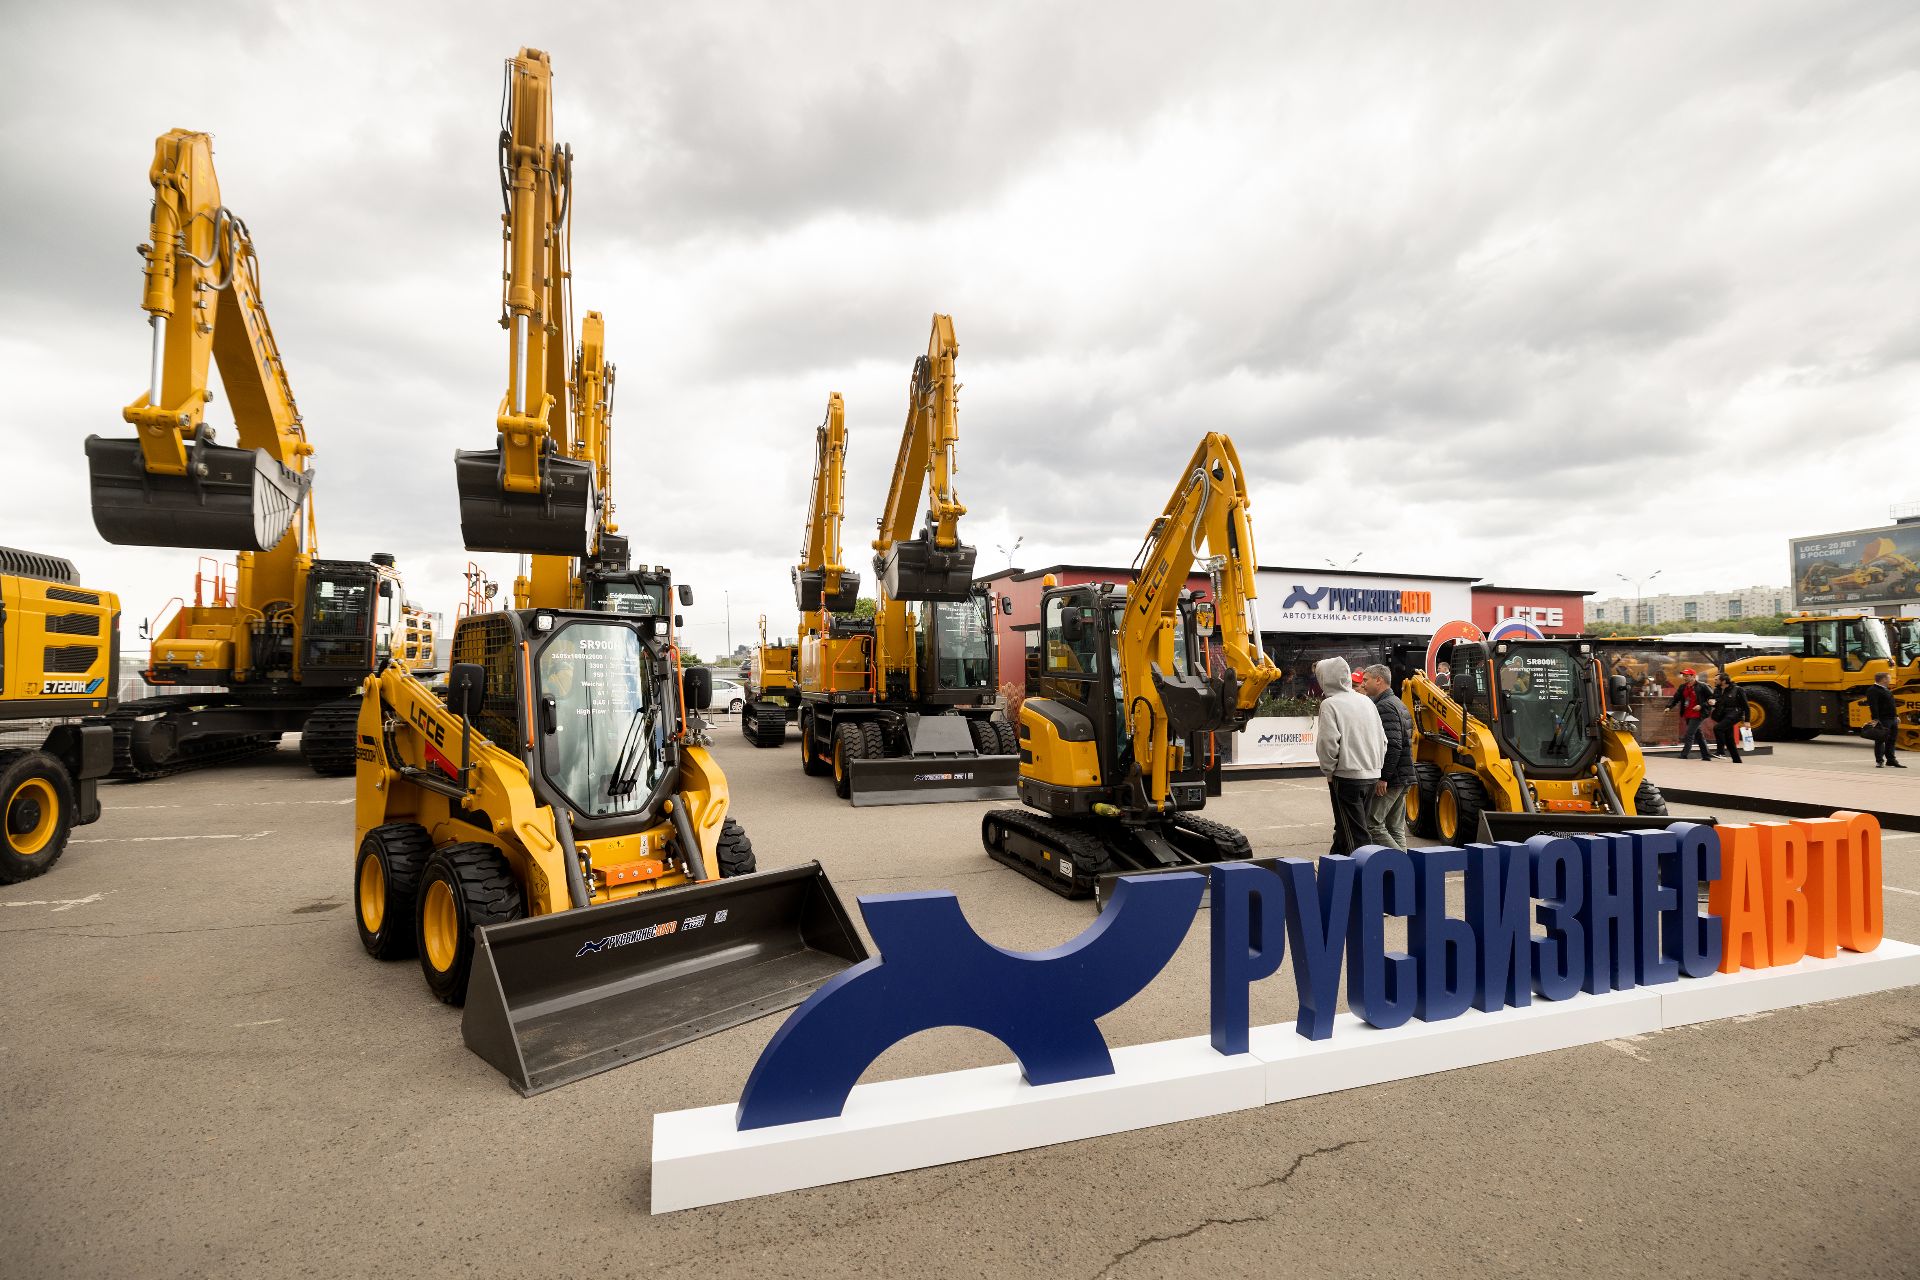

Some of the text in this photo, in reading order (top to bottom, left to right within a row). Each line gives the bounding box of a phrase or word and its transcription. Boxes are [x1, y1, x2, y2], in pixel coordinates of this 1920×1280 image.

[1329, 587, 1432, 614] РУСБИЗНЕСАВТО
[1282, 611, 1431, 623] АВТОТЕХНИКА СЕРВИС ЗАПЧАСТИ
[1526, 658, 1556, 666] SR800H
[410, 701, 446, 748] LGCE
[1211, 811, 1883, 1056] РУСБИЗНЕСАВТО
